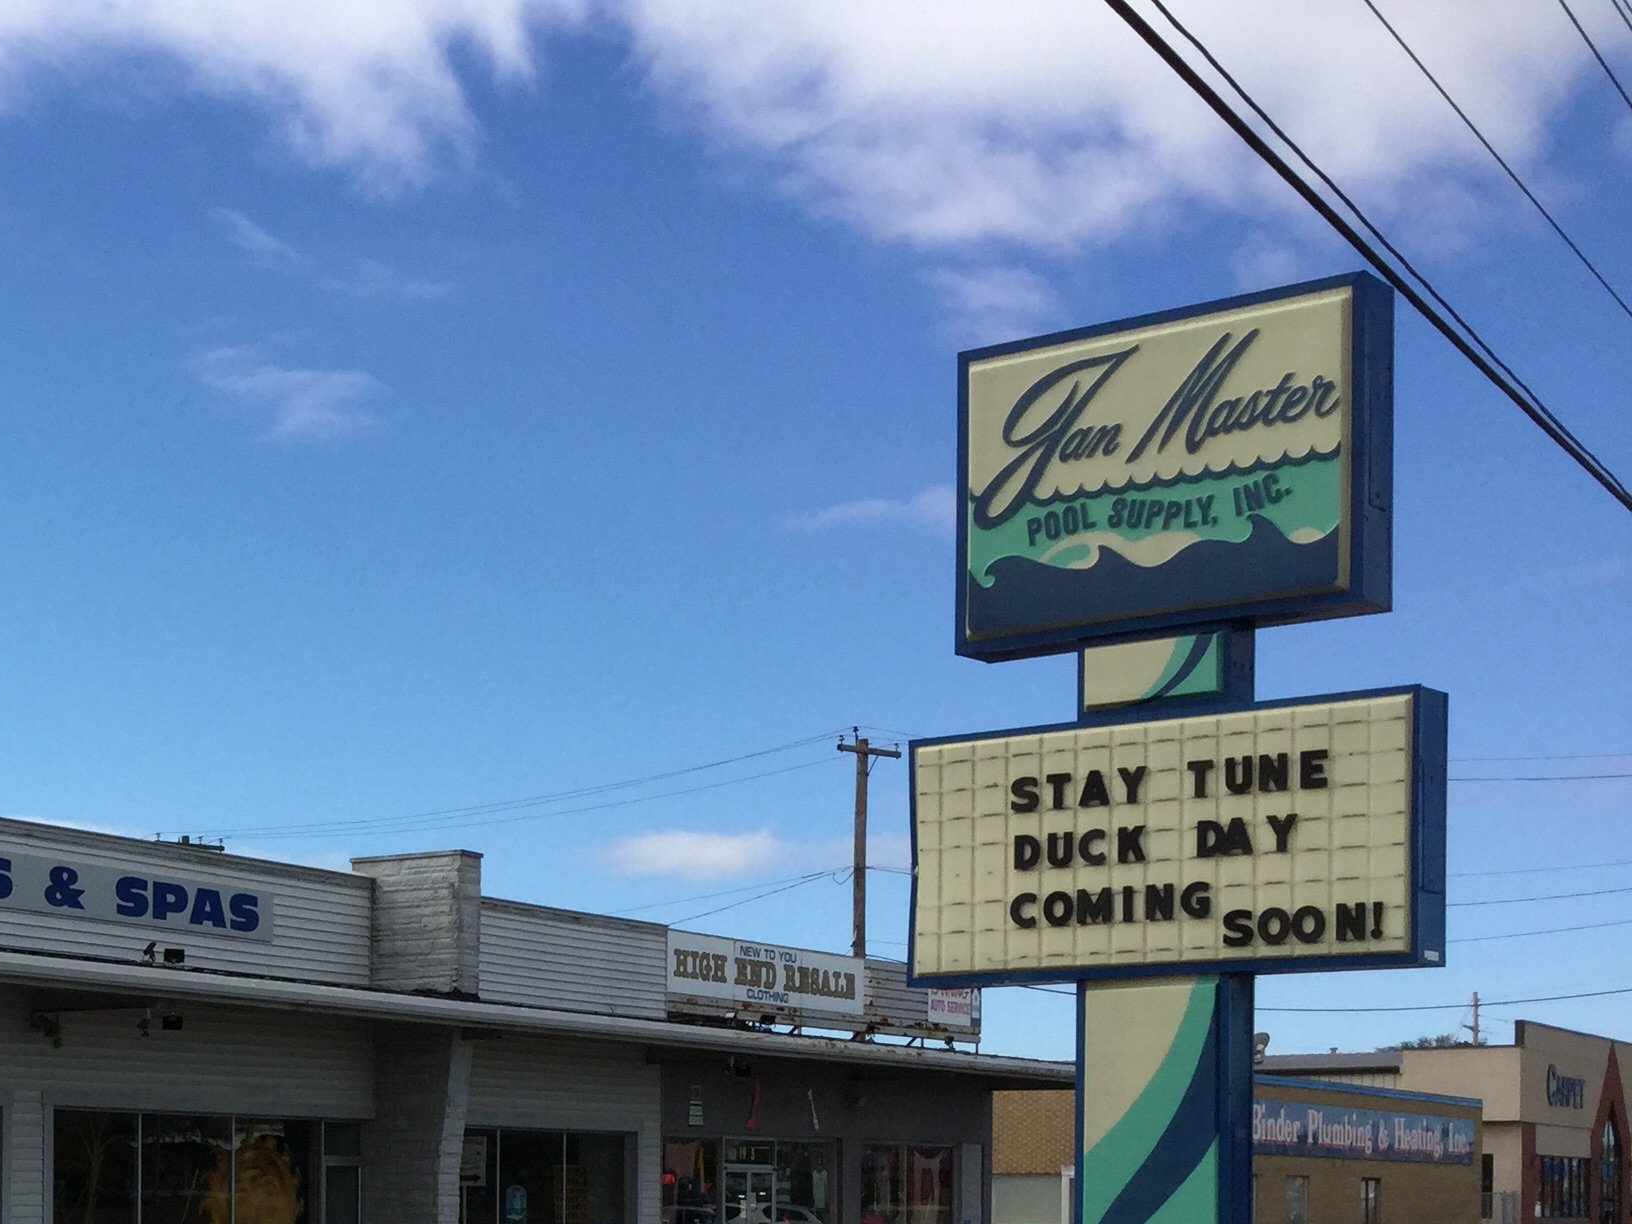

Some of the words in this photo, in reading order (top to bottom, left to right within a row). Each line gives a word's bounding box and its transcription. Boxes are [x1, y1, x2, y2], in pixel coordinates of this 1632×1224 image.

[1127, 328, 1340, 464] Master
[1027, 505, 1097, 548] POOL
[1107, 488, 1219, 530] SUPPLY,
[1233, 472, 1292, 516] INC.
[1010, 765, 1147, 814] STAY
[1186, 749, 1330, 795] TUNE
[1013, 825, 1146, 870] DUCK
[1196, 814, 1298, 858] DAY
[44, 866, 84, 909] &
[115, 876, 260, 933] SPAS
[1009, 881, 1212, 929] COMING
[1222, 901, 1384, 947] SOON!
[673, 949, 728, 983] HIGH
[734, 957, 777, 990] END
[783, 964, 856, 1000] RESALE
[739, 945, 762, 957] NEW
[764, 949, 776, 961] TO
[778, 951, 798, 964] YOU
[746, 988, 789, 1004] CLOTHING
[1252, 1103, 1301, 1143] Binder
[1307, 1108, 1373, 1155] Plumbing
[1378, 1119, 1389, 1151] &
